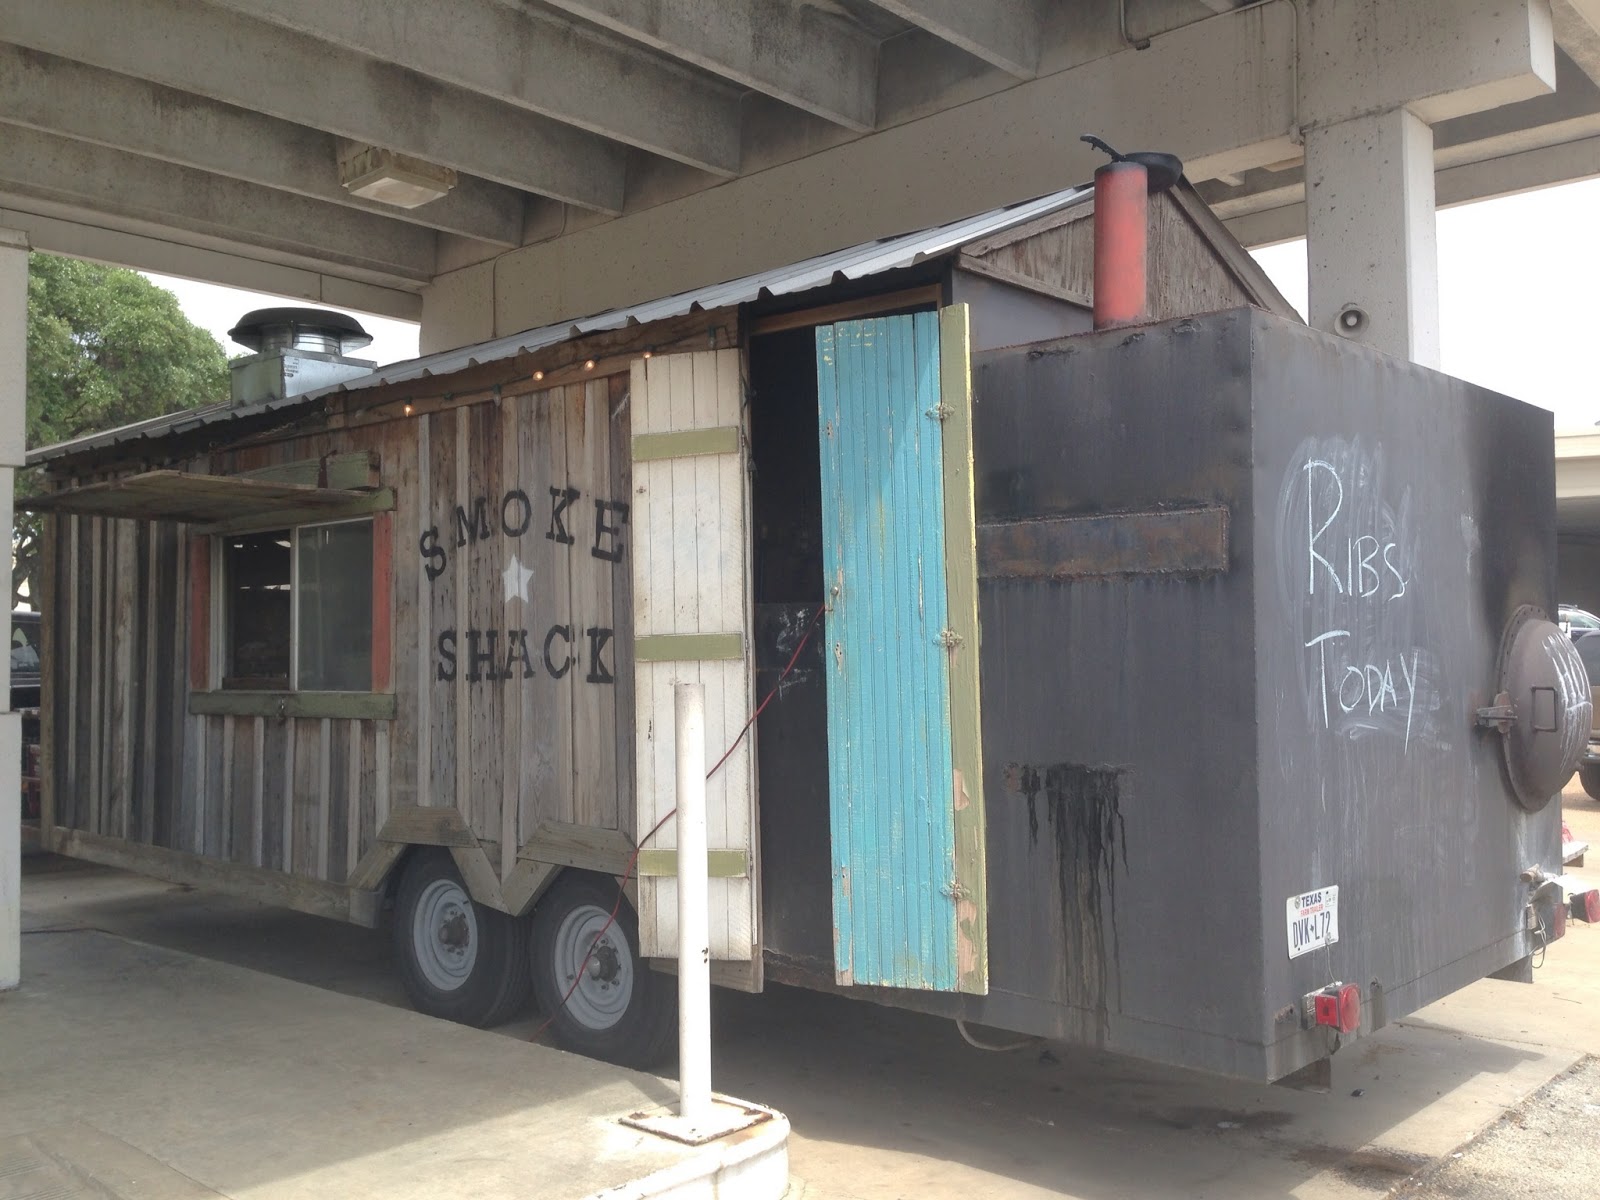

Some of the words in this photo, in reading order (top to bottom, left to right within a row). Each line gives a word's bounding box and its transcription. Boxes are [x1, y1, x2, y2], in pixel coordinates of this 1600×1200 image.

[420, 486, 630, 581] SMOKE
[1303, 457, 1409, 600] RIBS
[438, 625, 614, 684] SHACK
[1305, 630, 1418, 755] TODAY
[1302, 892, 1322, 908] TEXAS
